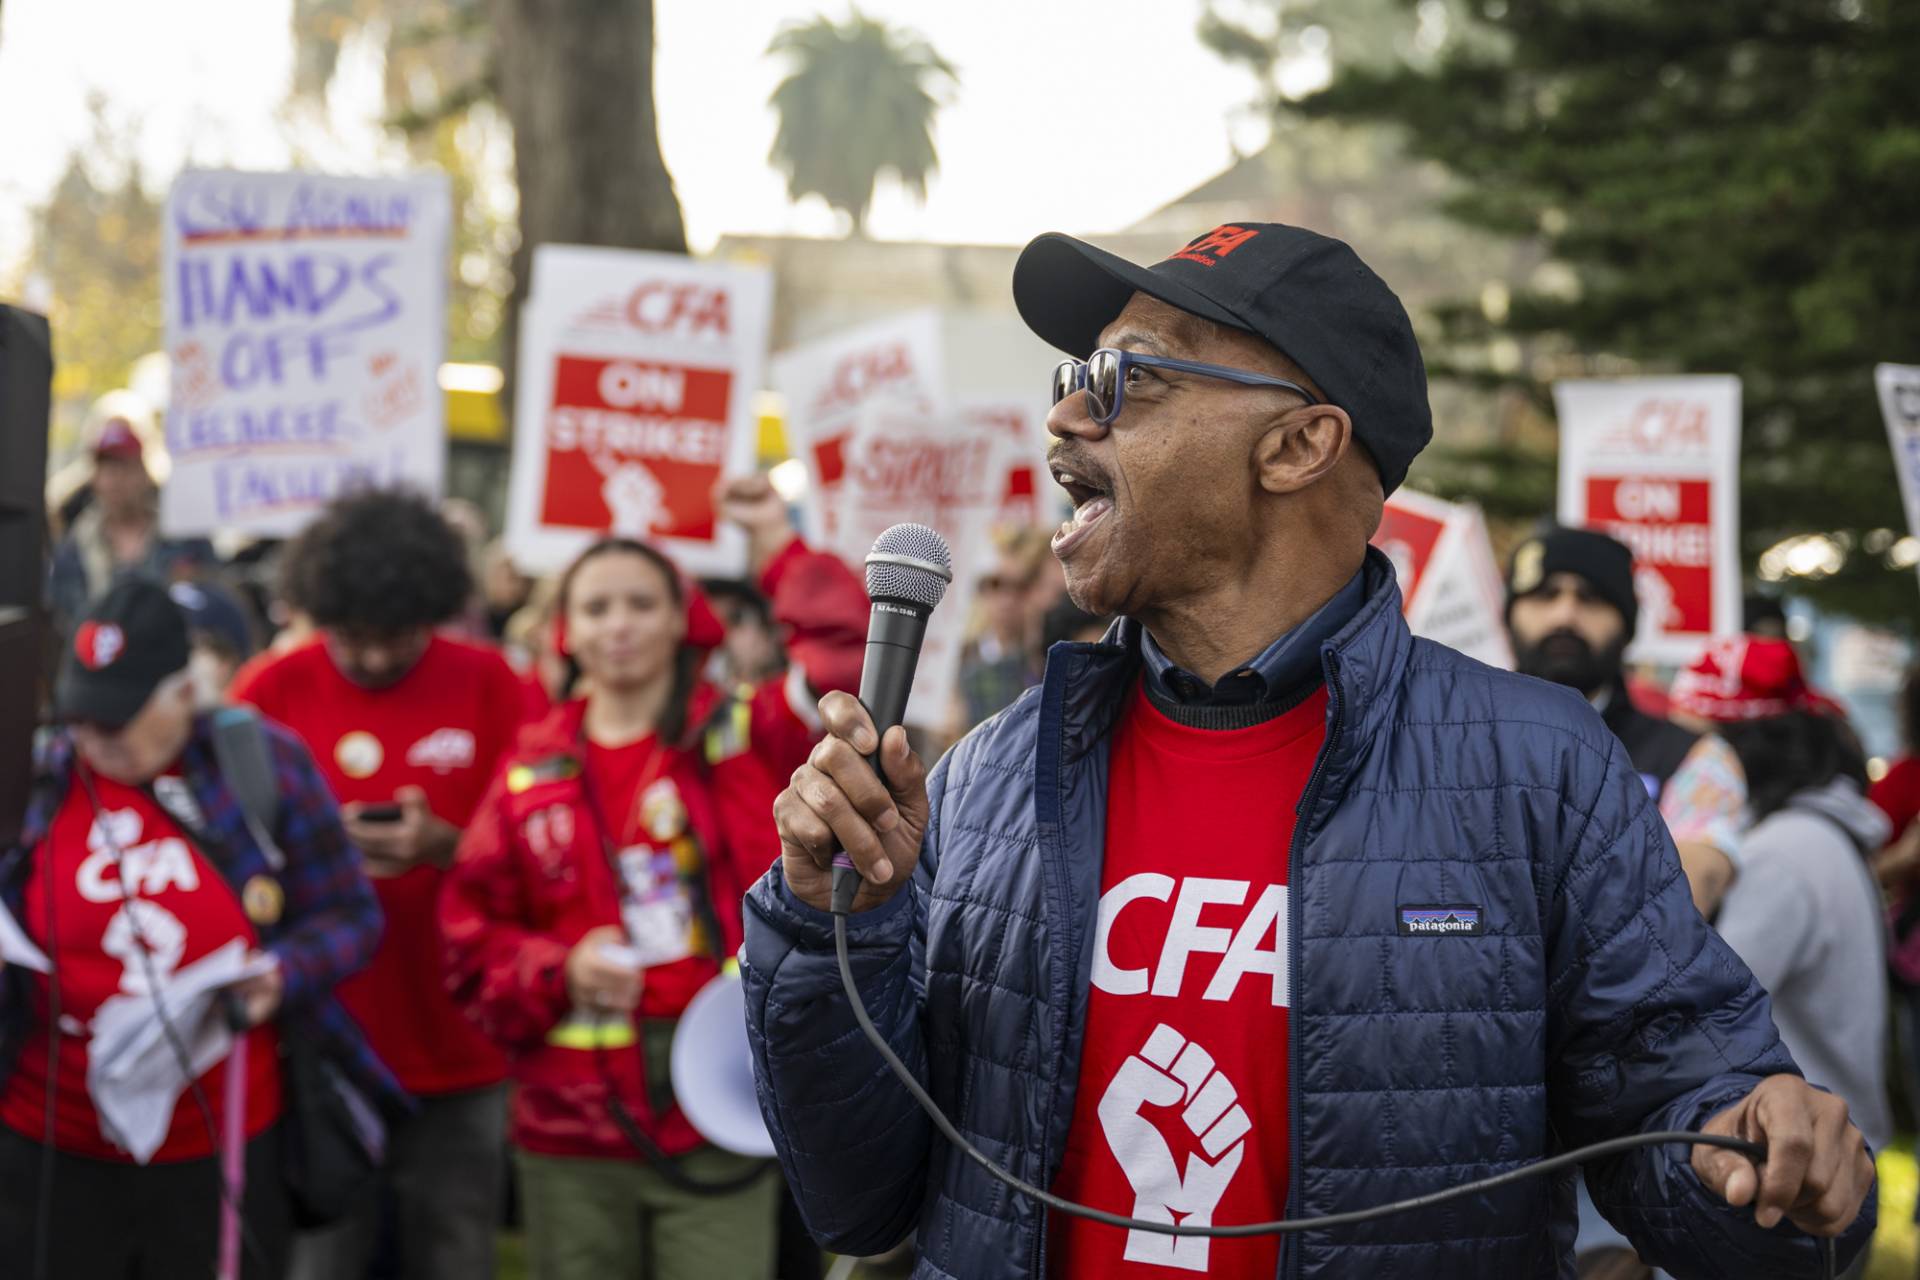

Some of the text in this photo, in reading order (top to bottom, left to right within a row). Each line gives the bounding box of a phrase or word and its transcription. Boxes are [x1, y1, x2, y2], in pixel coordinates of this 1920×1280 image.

[1172, 224, 1259, 257] FA
[178, 253, 404, 330] HANDS
[626, 278, 732, 337] CFA
[220, 328, 352, 390] OFF
[598, 362, 686, 412] ON
[1613, 477, 1681, 521] ON
[1604, 522, 1711, 567] RIKE!
[75, 836, 200, 904] CFA
[1090, 871, 1291, 1008] CFA
[1409, 921, 1472, 933] patagonia
